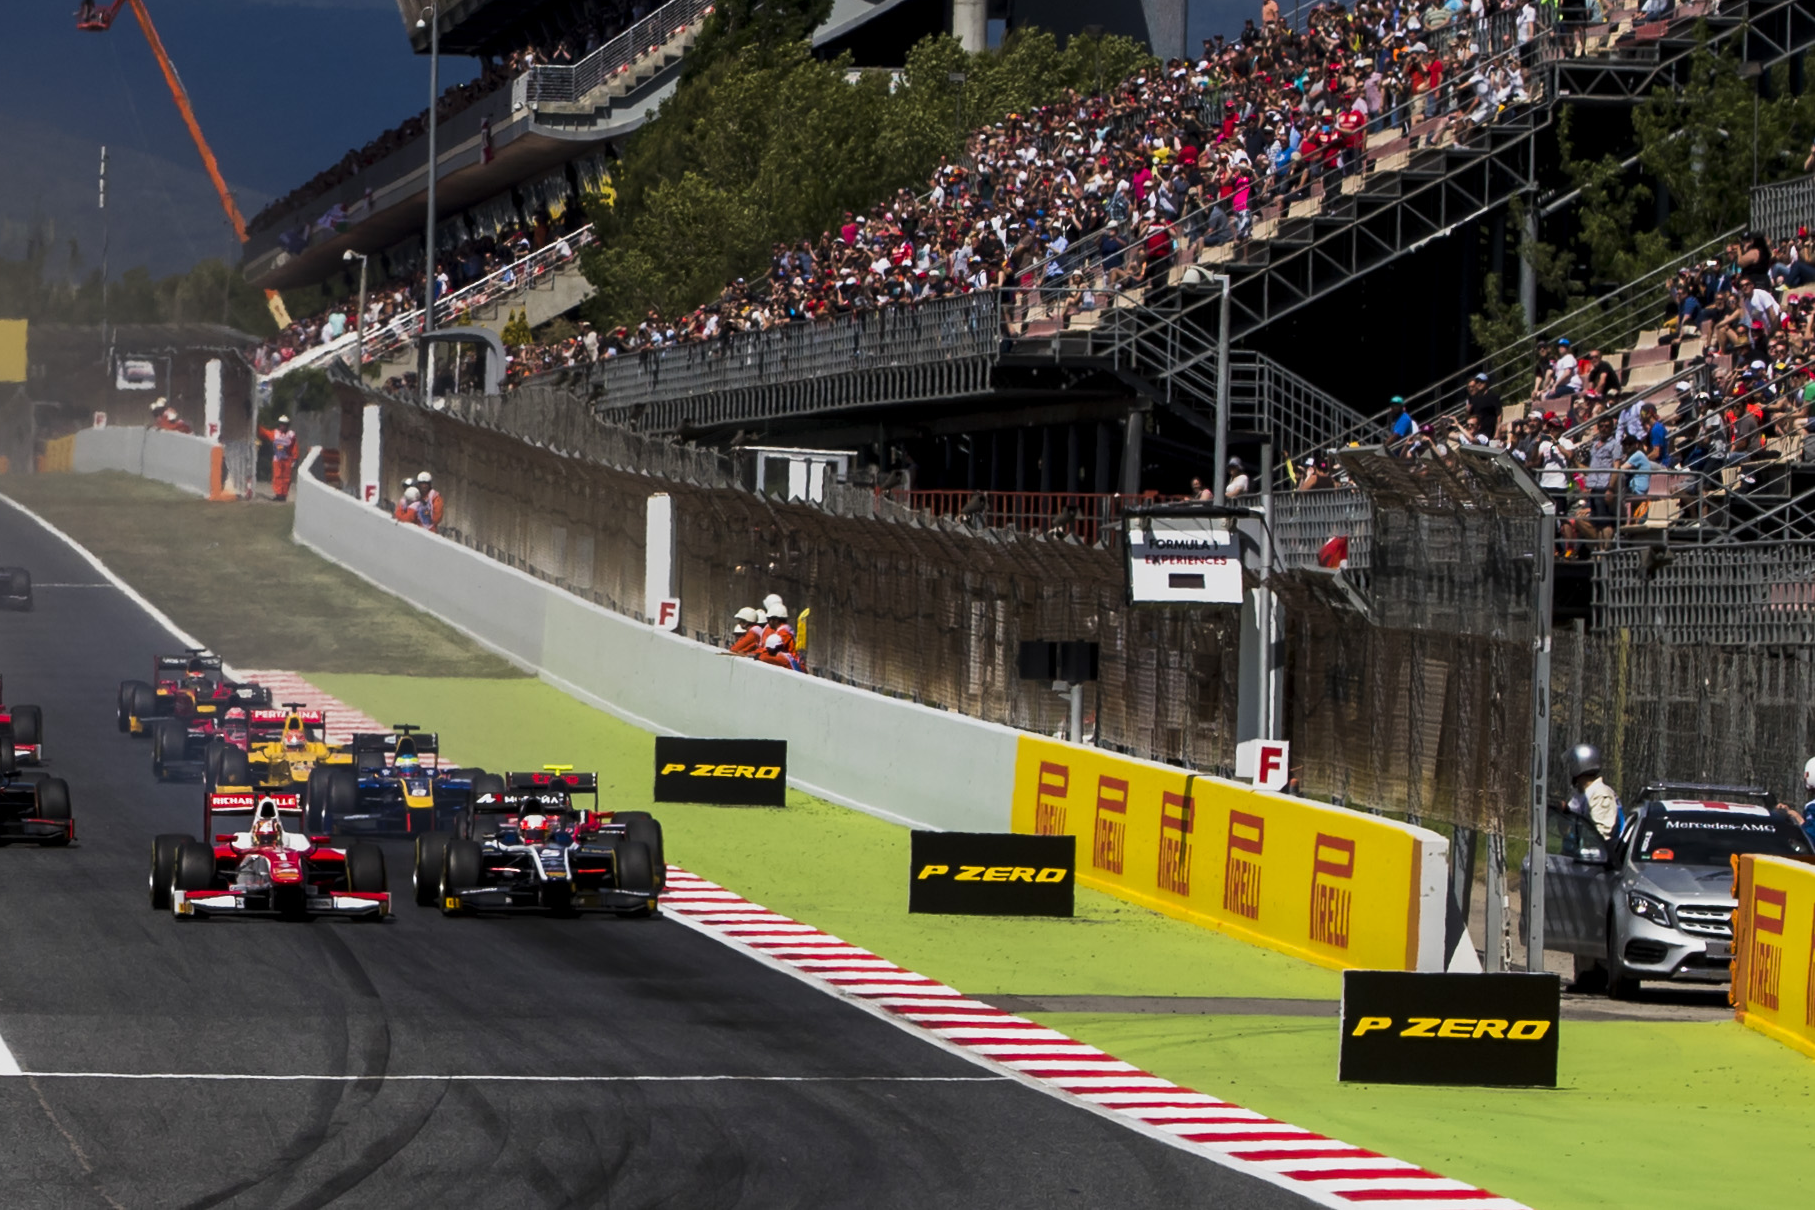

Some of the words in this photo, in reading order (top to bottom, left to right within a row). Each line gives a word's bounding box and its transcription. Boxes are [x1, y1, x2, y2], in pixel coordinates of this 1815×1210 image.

[365, 485, 377, 502] F
[1148, 538, 1211, 550] FORMULA
[1212, 540, 1219, 551] 1
[1145, 554, 1228, 566] EXPERIENCES
[659, 601, 676, 625] F
[254, 709, 319, 720] PERTAINA
[660, 763, 686, 776] P
[689, 764, 782, 780] ZERO
[1258, 746, 1283, 784] F
[1093, 774, 1129, 876] PIRELLI
[1665, 820, 1777, 833] Mercedes-AMG
[1157, 791, 1195, 897] PIRELLI
[917, 864, 950, 880] P
[953, 865, 1068, 883] ZERO
[1223, 809, 1265, 921] PIRELLI
[1309, 832, 1356, 950] PIRELLI
[1748, 884, 1787, 1011] PIRELLI
[1352, 1016, 1393, 1037] P
[1399, 1017, 1551, 1040] ZERO
